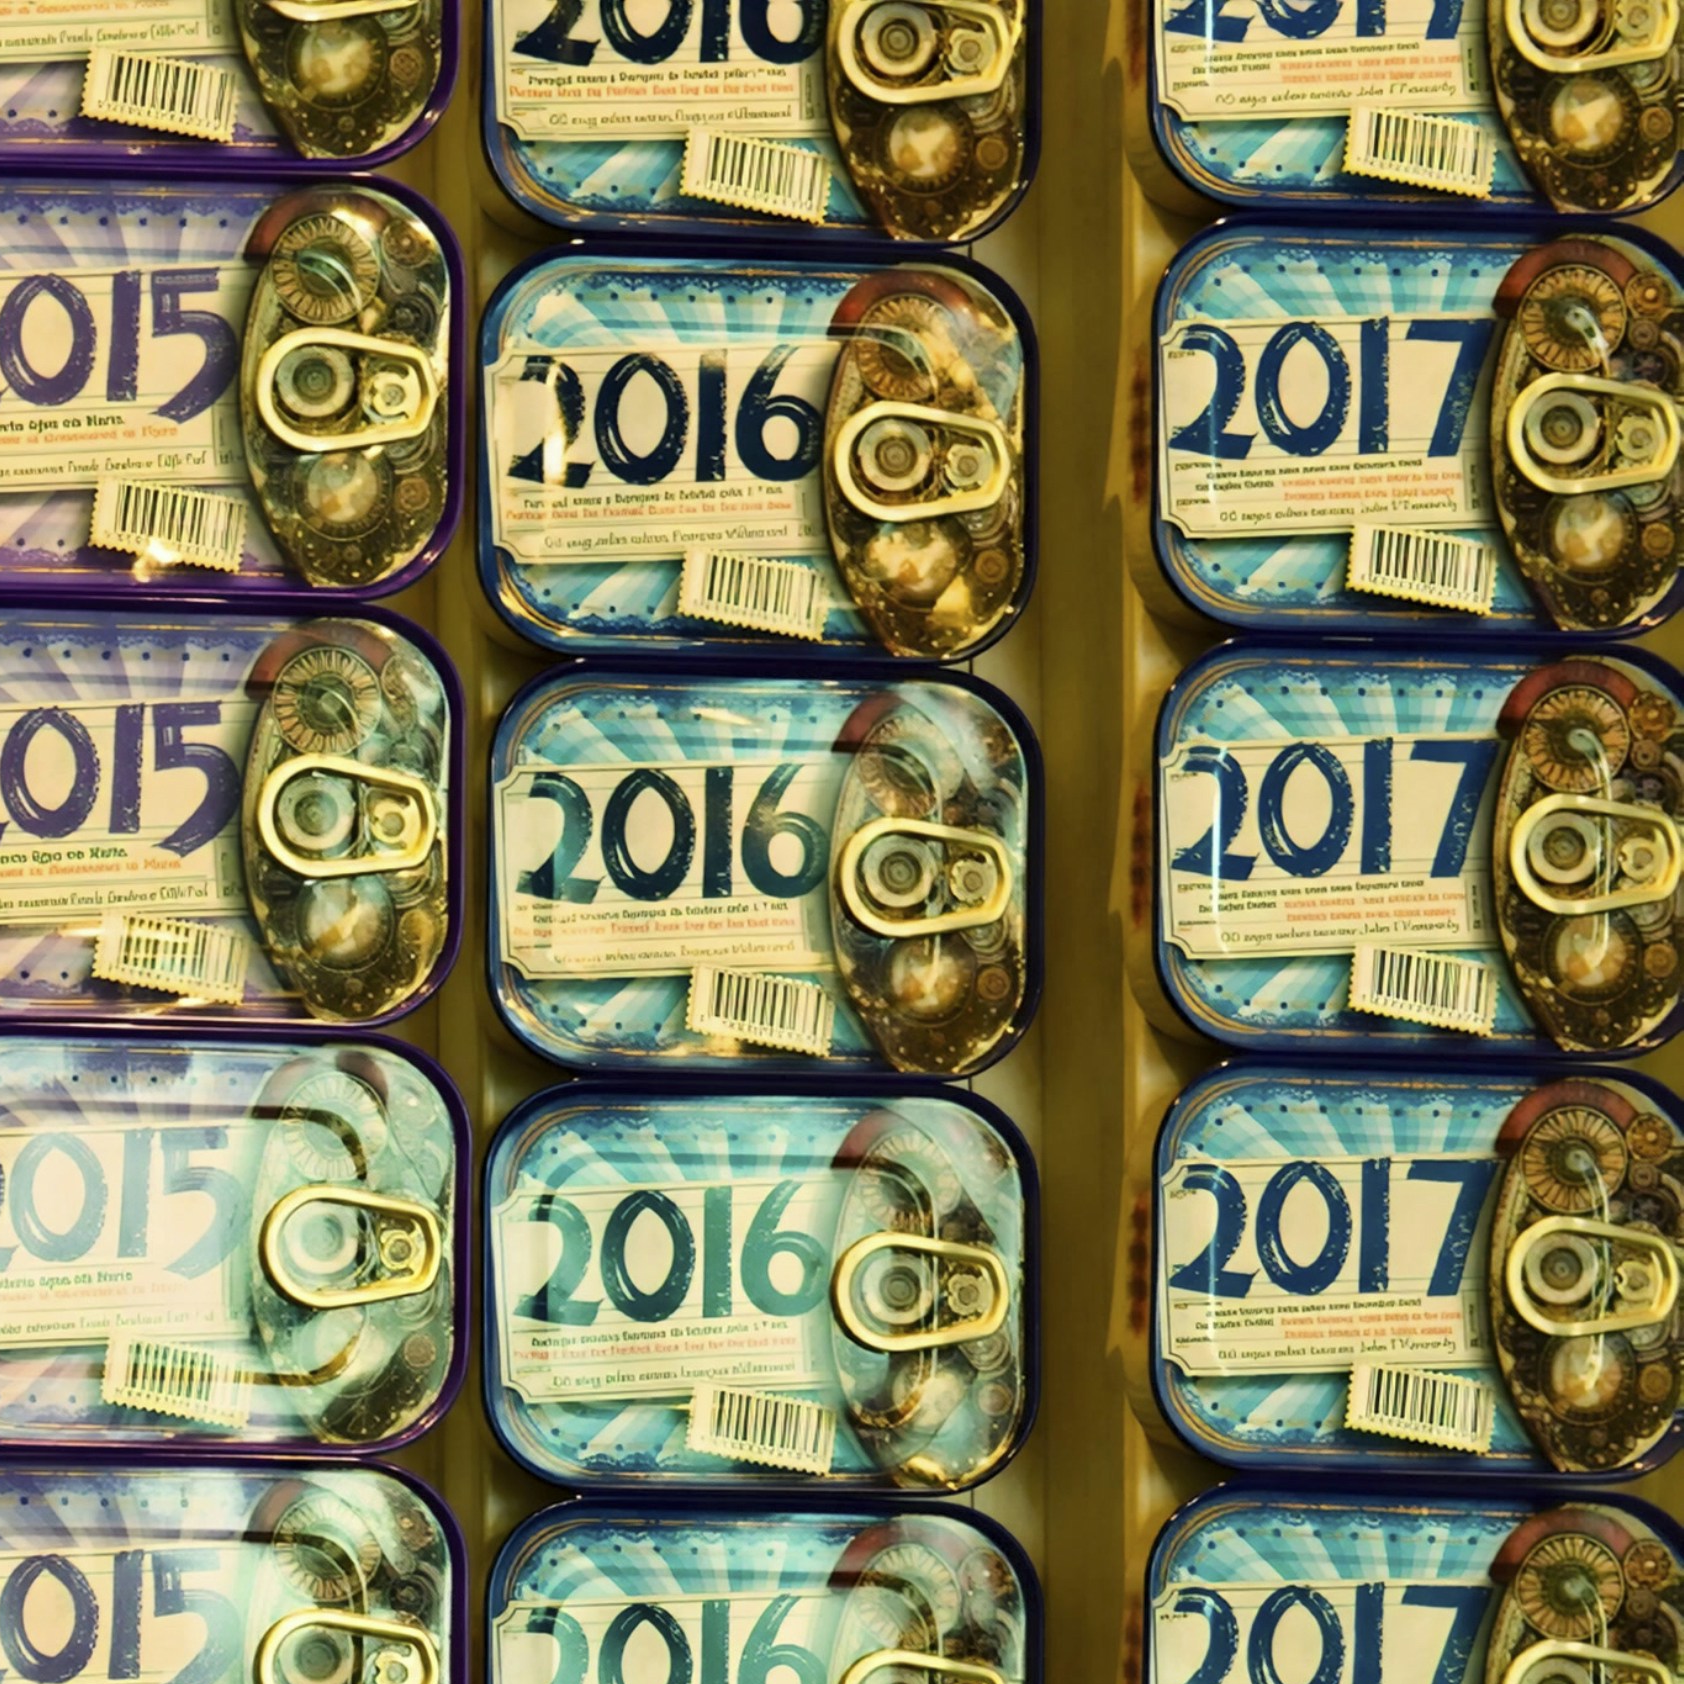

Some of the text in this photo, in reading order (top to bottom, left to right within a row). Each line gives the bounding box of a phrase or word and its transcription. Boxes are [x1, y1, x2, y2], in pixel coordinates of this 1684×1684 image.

[510, 344, 828, 489] 2016
[1168, 316, 1497, 458] 2017
[516, 762, 830, 905] 2016
[1169, 738, 1500, 880] 2017
[515, 1179, 826, 1323] 2016
[1175, 1157, 1502, 1296] 2017
